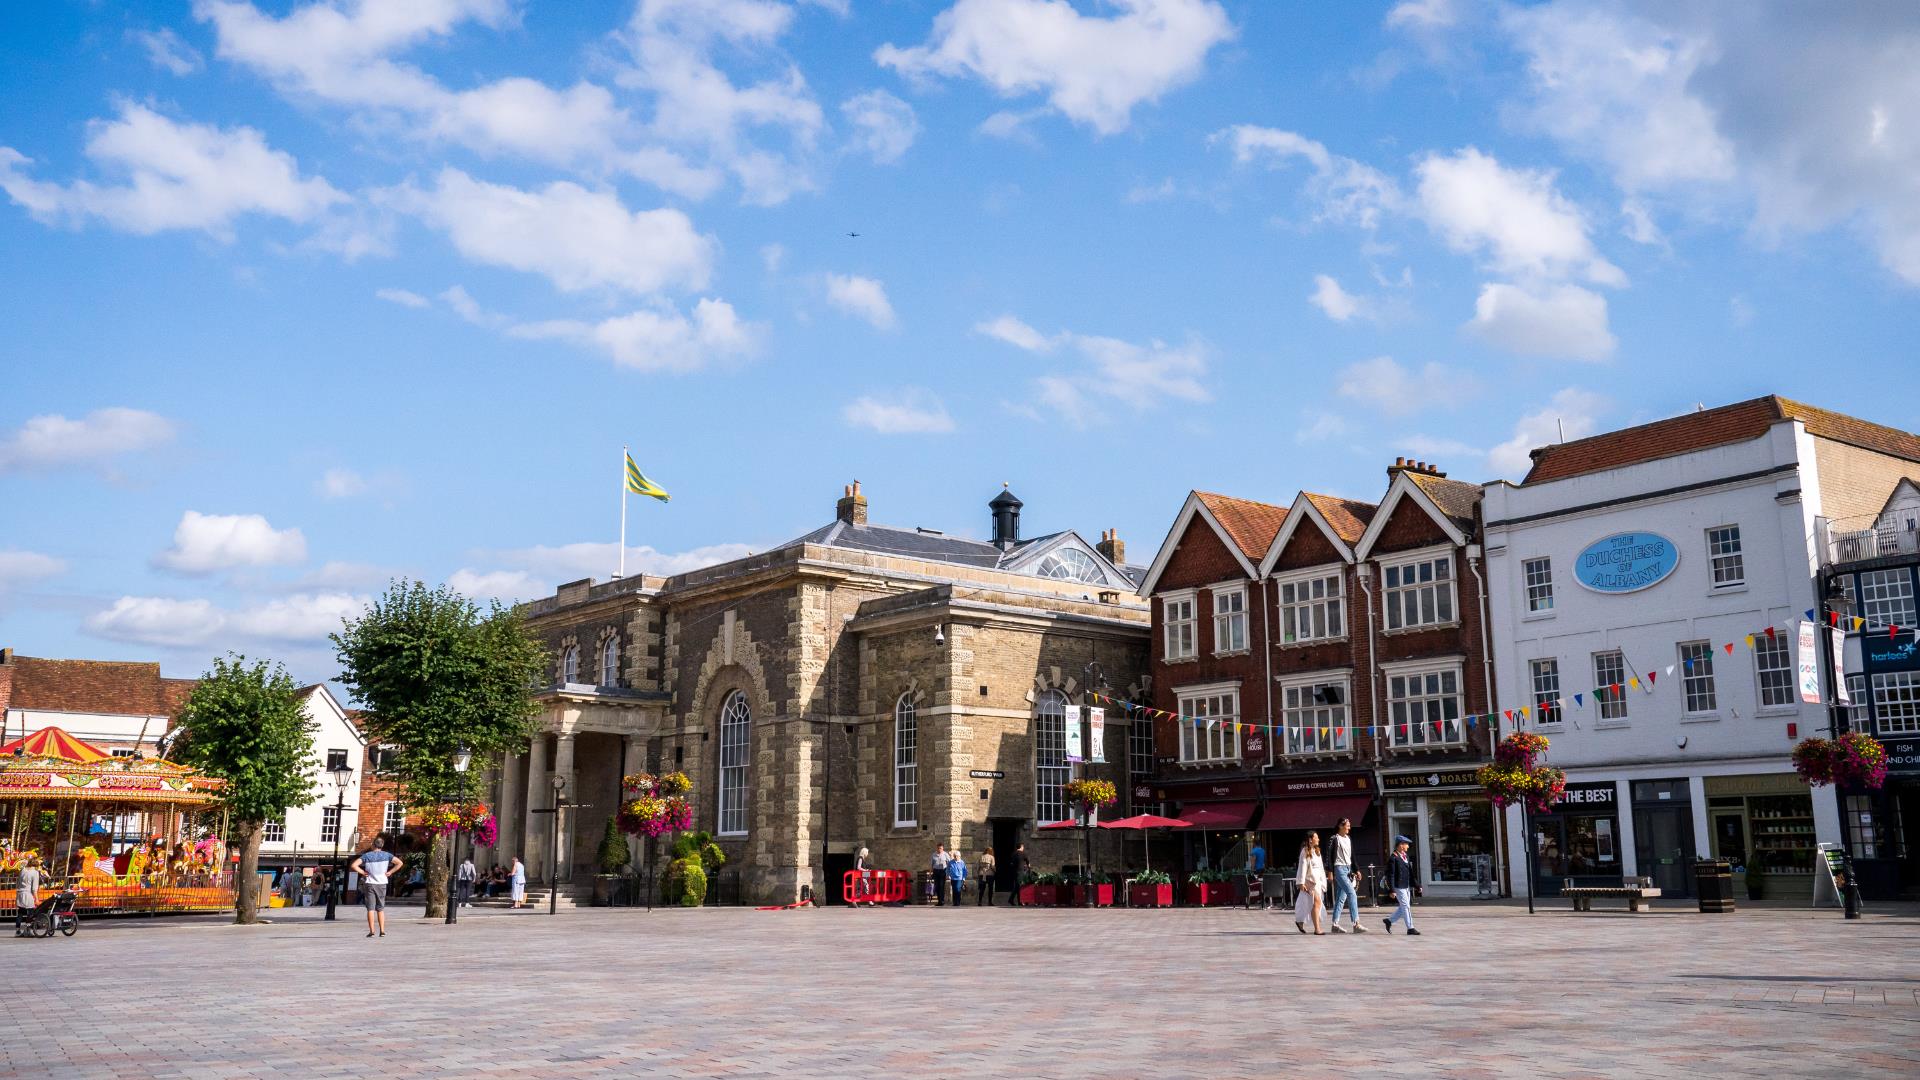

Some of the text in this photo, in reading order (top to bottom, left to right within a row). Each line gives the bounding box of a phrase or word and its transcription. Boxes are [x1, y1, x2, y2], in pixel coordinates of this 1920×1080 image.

[1611, 536, 1633, 548] THE
[1585, 542, 1665, 568] DUCHESS
[1617, 561, 1632, 572] OF
[1590, 562, 1661, 588] ALBANY
[1896, 744, 1913, 752] FISH
[1886, 756, 1904, 764] AND
[1400, 776, 1426, 785] YORK
[1441, 773, 1474, 783] ROAST
[1565, 790, 1584, 803] THE
[1585, 788, 1613, 803] BEST
